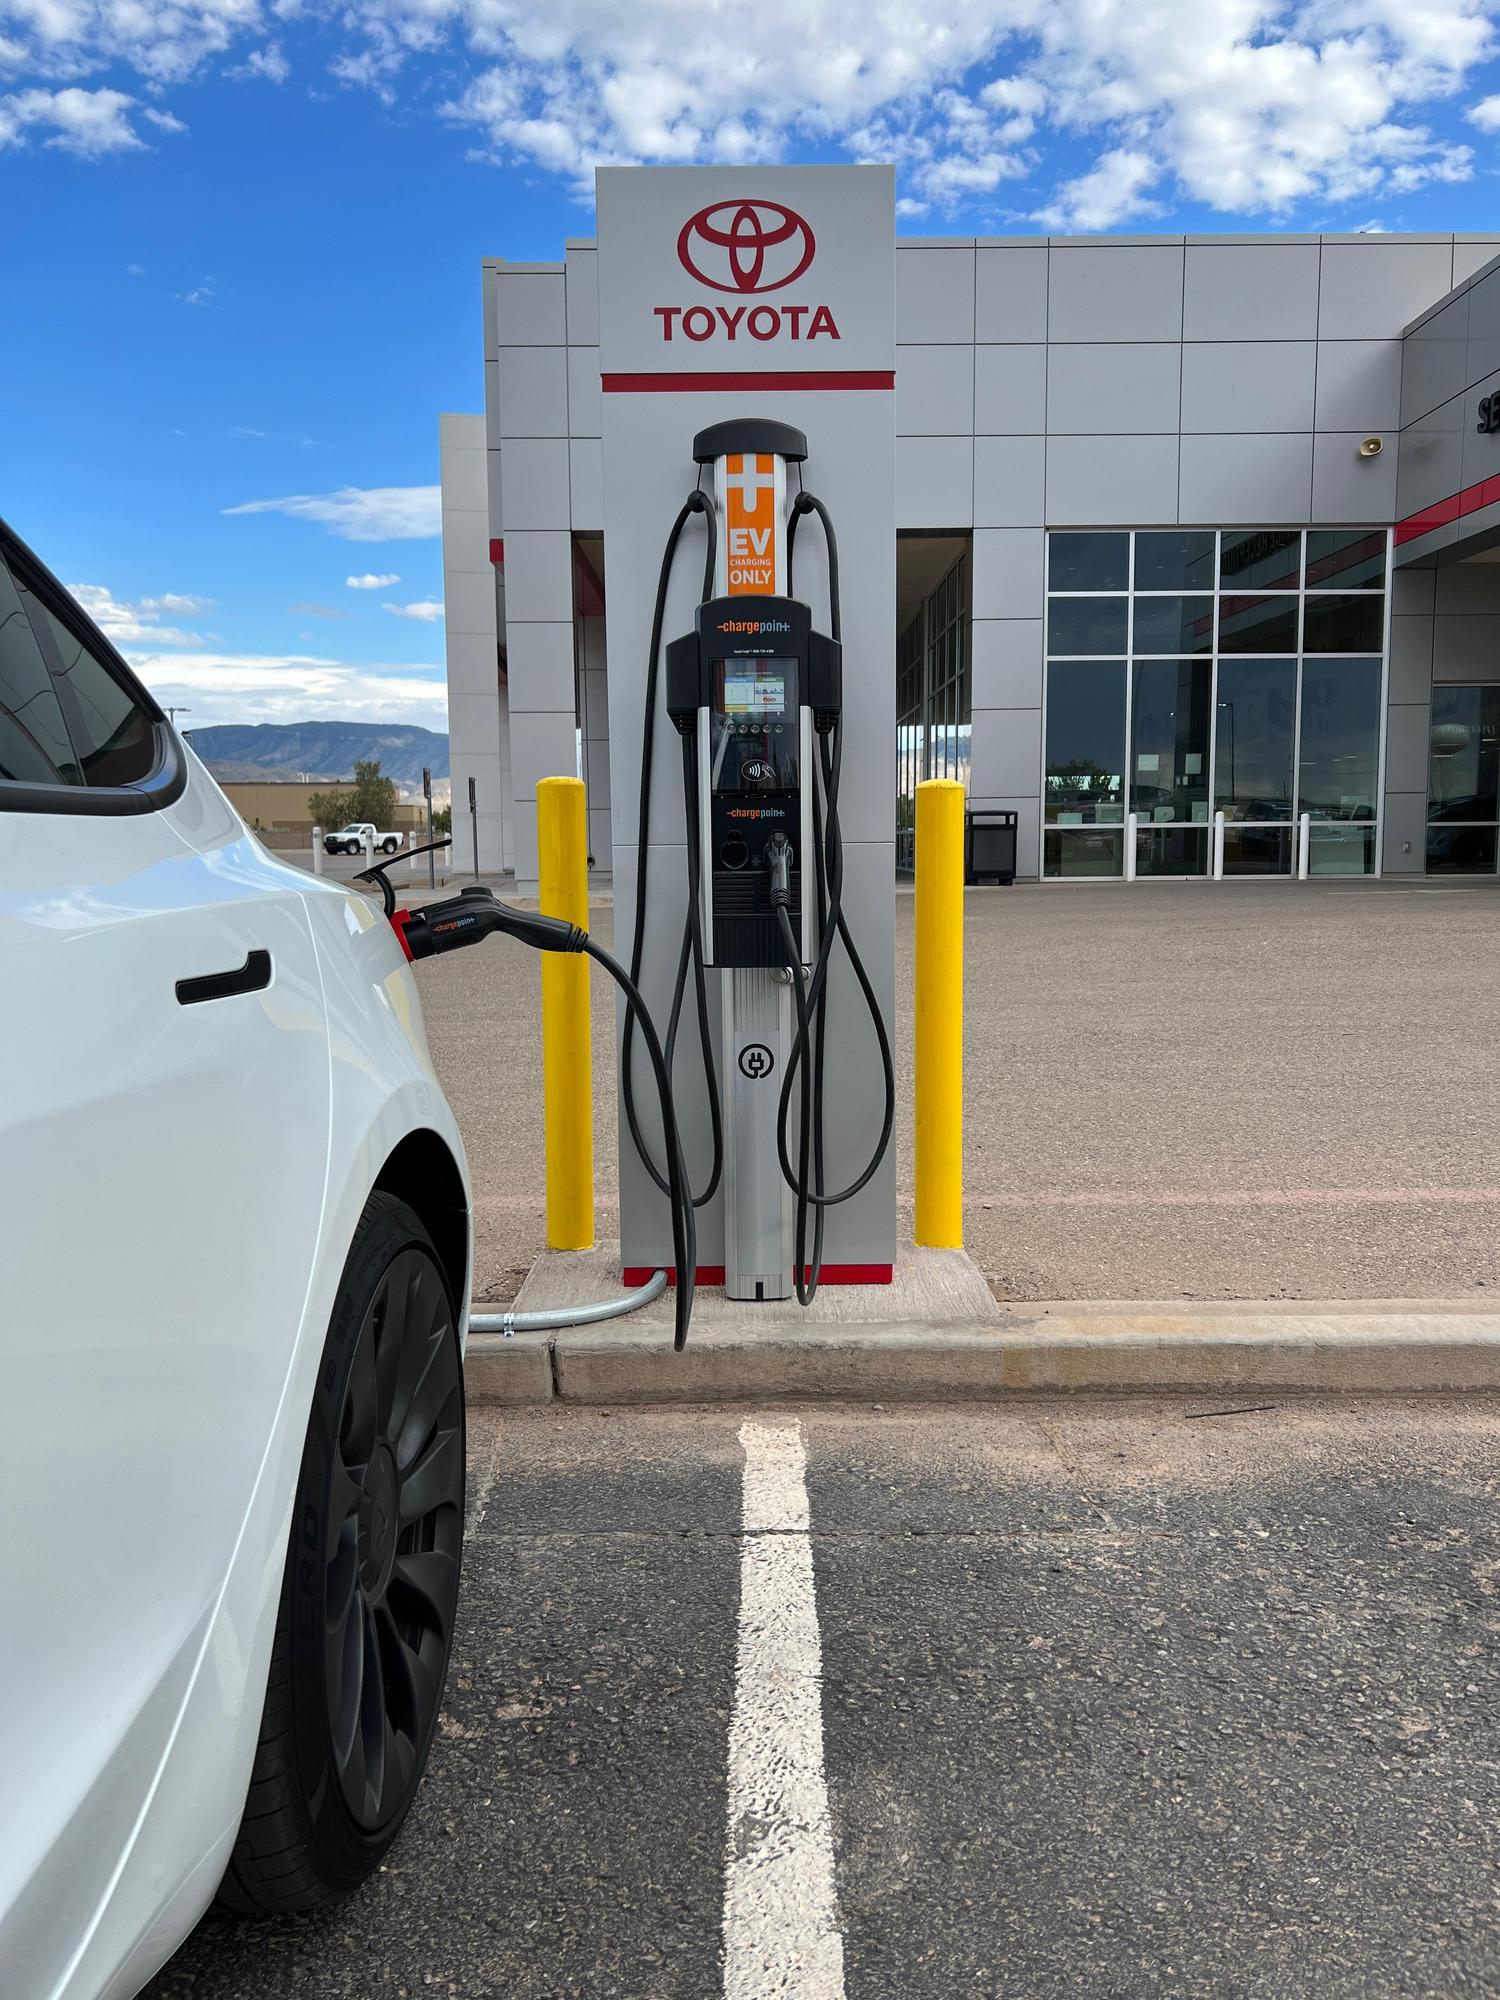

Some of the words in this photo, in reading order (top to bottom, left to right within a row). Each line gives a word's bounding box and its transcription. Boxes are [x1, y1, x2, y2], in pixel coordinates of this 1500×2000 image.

[653, 305, 841, 342] TOYOTA
[730, 527, 771, 556] EV
[730, 558, 771, 567] CHARGING
[730, 569, 772, 585] ONLY
